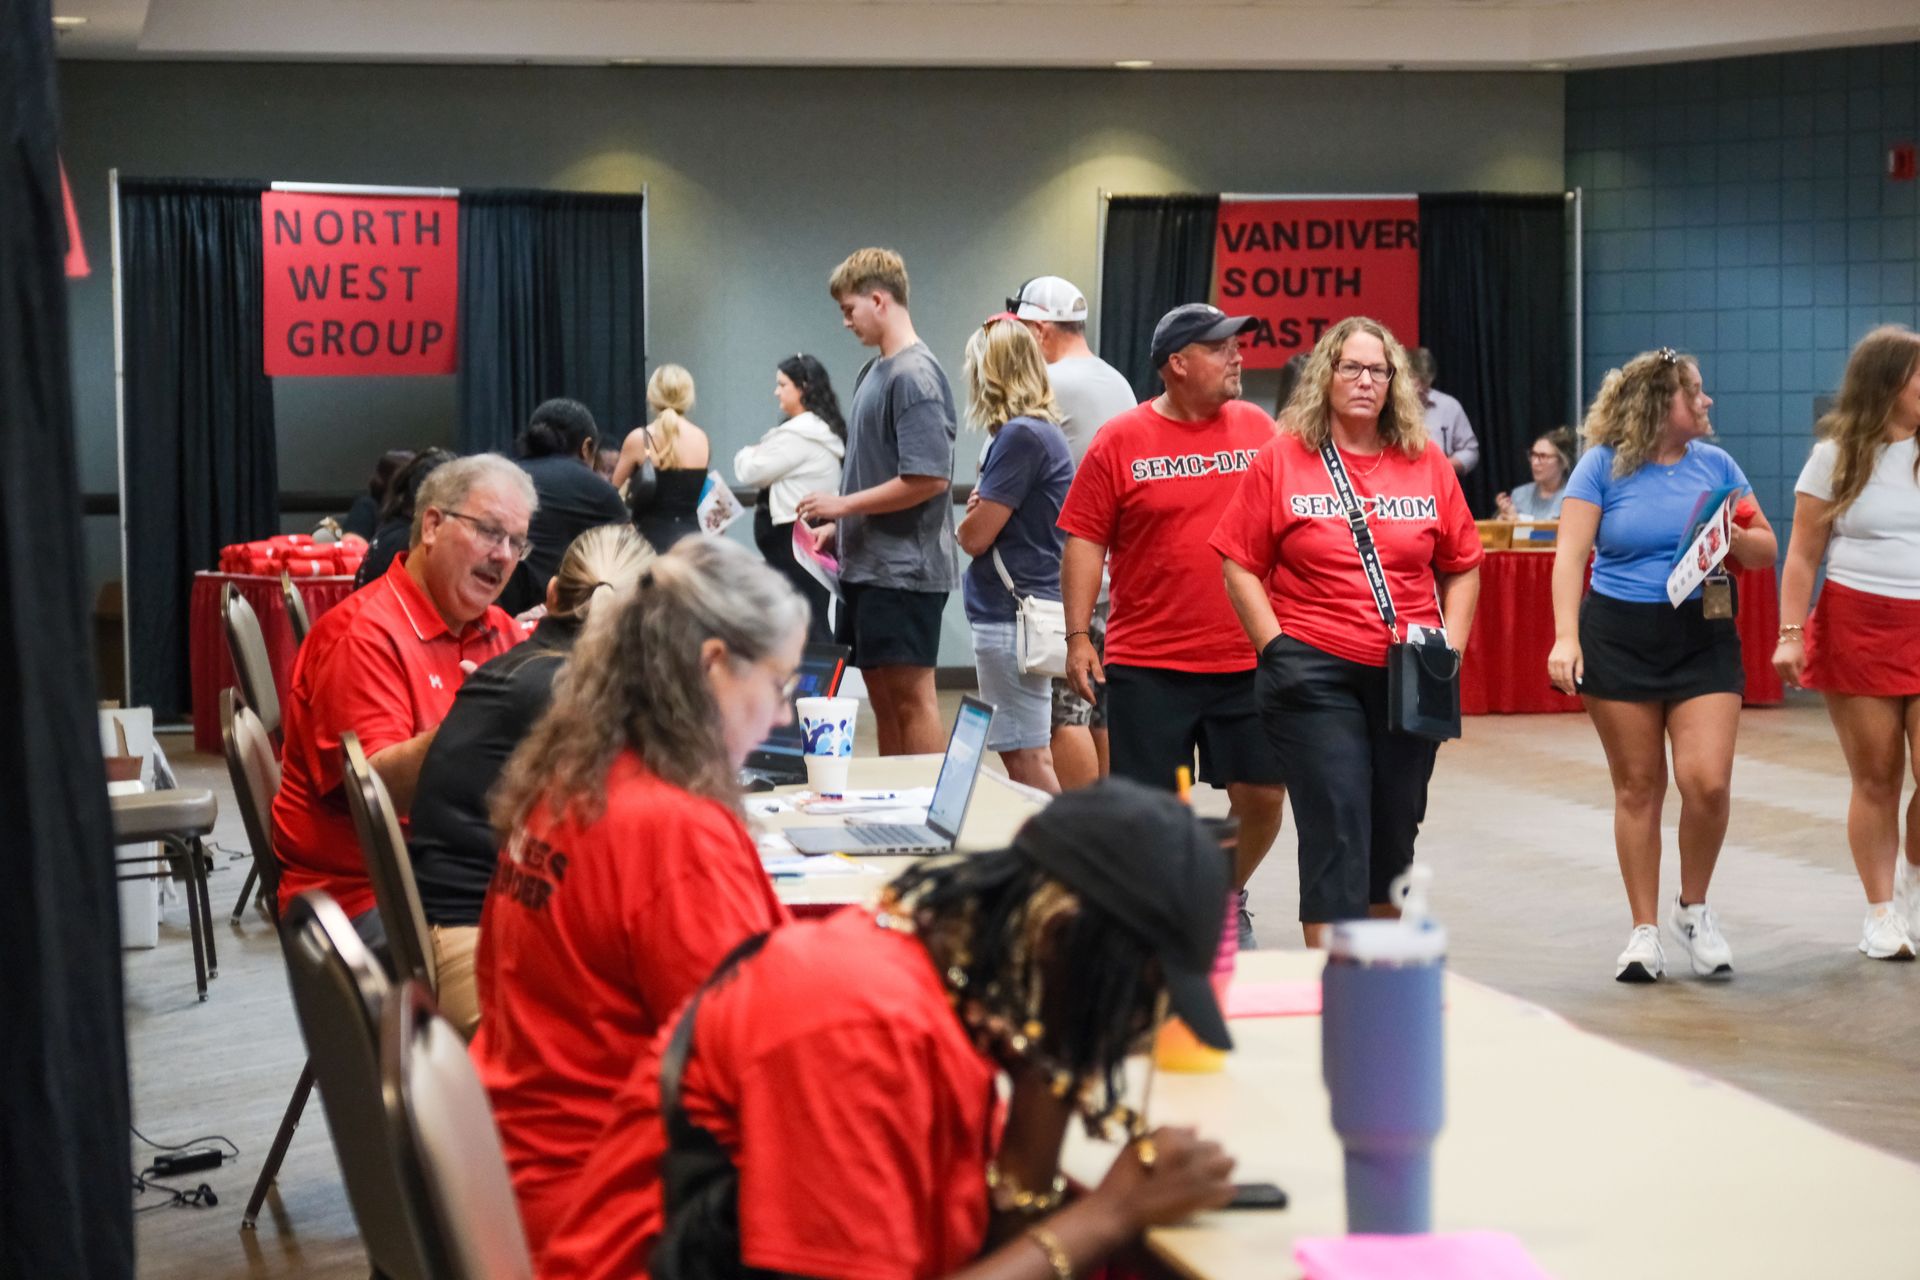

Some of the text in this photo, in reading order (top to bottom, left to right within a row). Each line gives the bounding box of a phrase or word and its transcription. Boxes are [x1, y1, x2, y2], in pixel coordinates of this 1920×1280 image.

[273, 209, 440, 247] NORTH
[1221, 218, 1419, 253] VANDIVER
[288, 263, 422, 302] WEST
[1221, 266, 1363, 298] SOUTH
[286, 319, 444, 358] GROUP
[1237, 316, 1331, 349] AST
[1131, 453, 1205, 482] SEMO
[1291, 494, 1438, 520] SEM MOM
